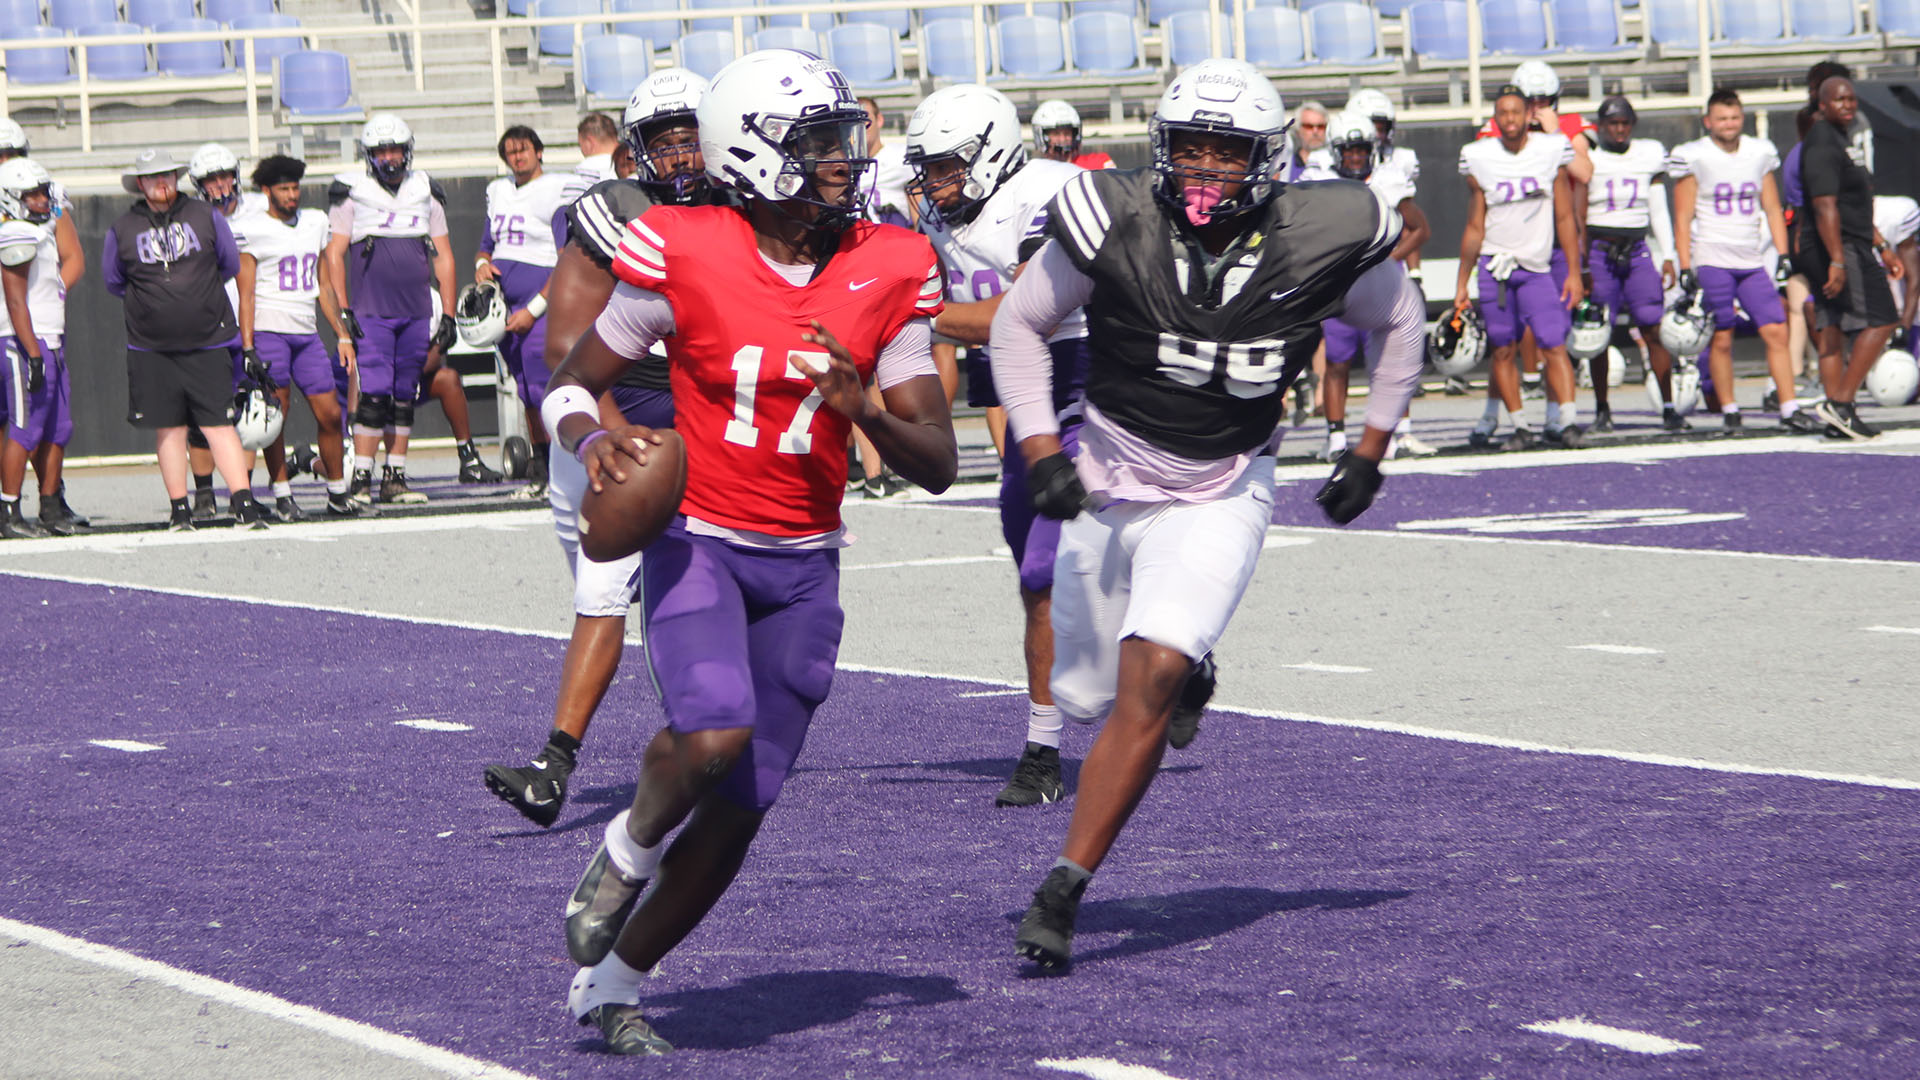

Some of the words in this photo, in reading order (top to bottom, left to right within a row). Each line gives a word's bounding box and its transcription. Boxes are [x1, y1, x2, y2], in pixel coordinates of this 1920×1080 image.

[1605, 178, 1638, 212] 17
[494, 214, 525, 246] 76
[278, 253, 318, 291] 80
[723, 344, 832, 454] 17
